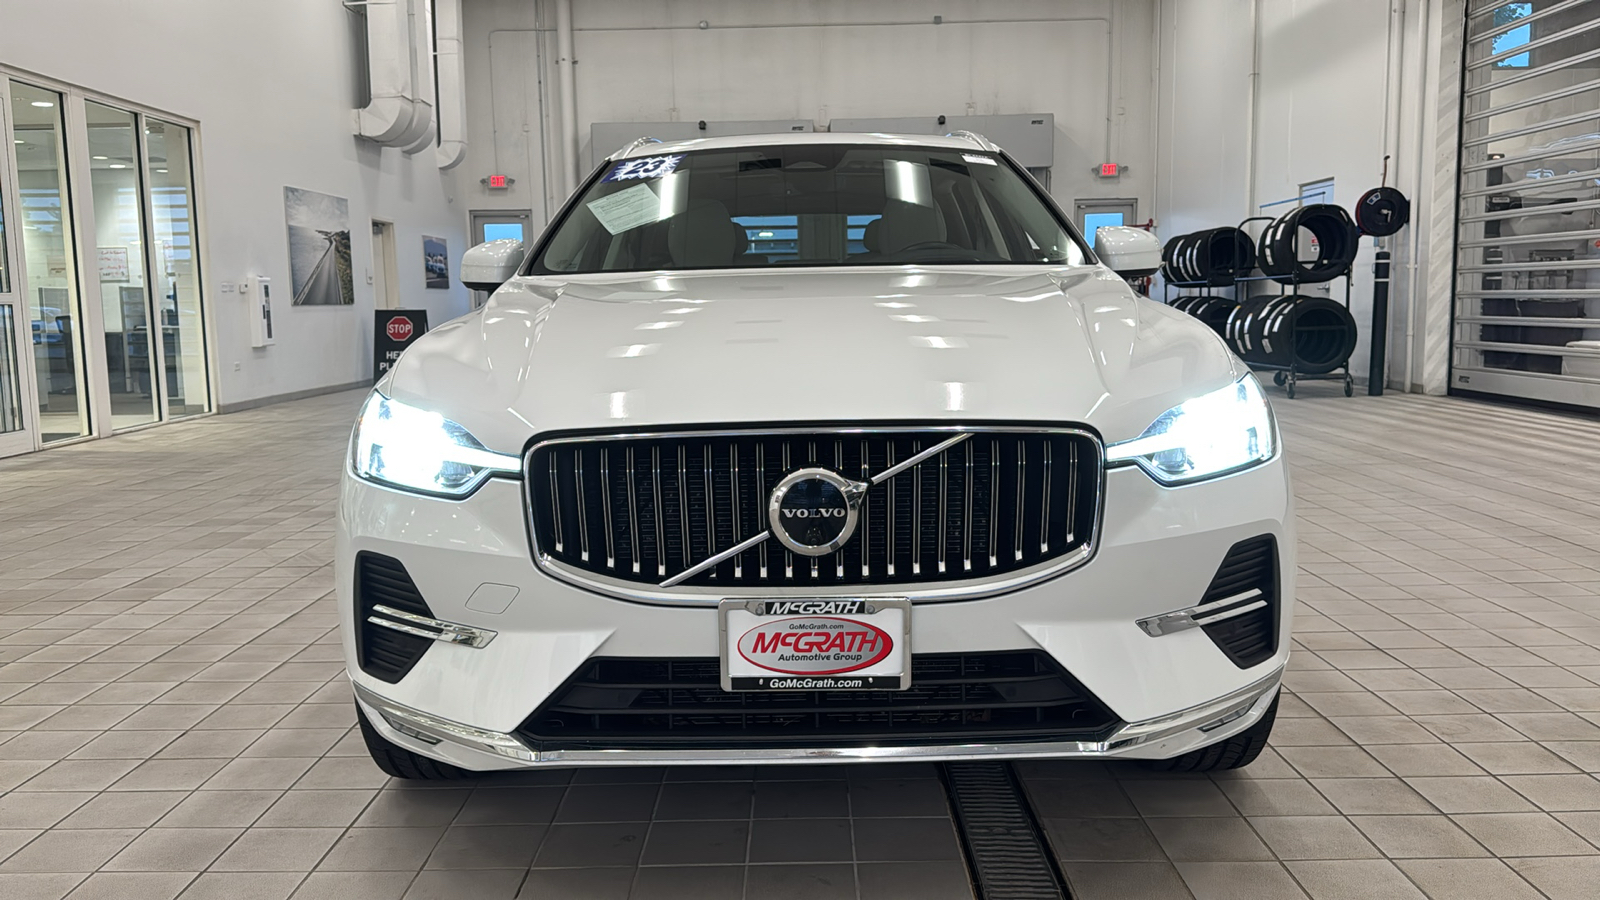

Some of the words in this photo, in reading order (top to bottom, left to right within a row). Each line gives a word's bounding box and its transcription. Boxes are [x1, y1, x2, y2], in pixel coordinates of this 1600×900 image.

[624, 160, 666, 175] 23
[388, 324, 411, 333] STOP
[782, 508, 846, 518] VOLVO
[778, 653, 831, 662] Automotive
[833, 653, 862, 662] Group
[769, 678, 862, 688] GoMcGrath.com
